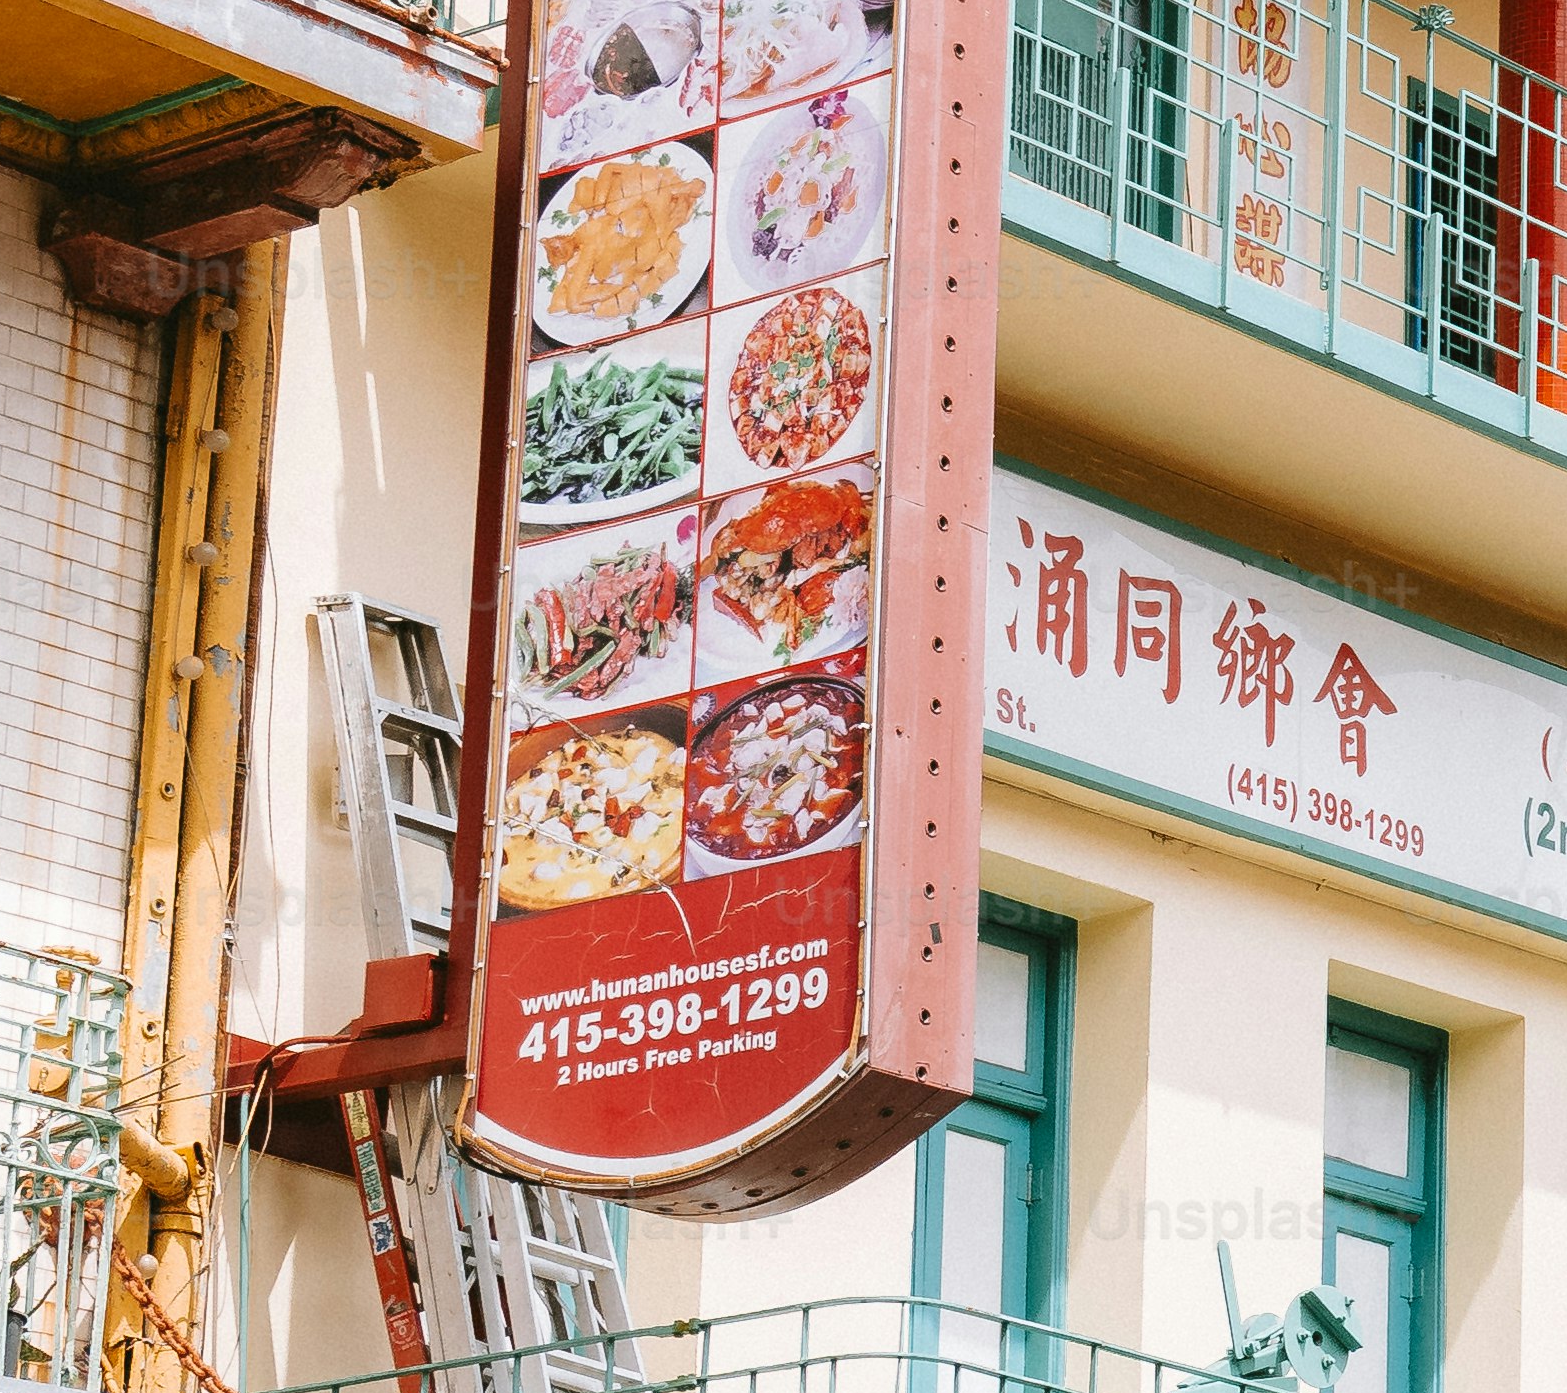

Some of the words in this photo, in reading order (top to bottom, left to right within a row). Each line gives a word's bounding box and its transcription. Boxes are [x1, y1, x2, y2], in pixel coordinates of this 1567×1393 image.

[996, 687, 1036, 733] St.
[1227, 763, 1300, 824] (415)
[1306, 787, 1426, 859] 398-1299
[518, 965, 830, 1064] 415-398-1299
[520, 934, 829, 1016] www.hunanhousesf.com
[557, 1064, 572, 1087] 2
[577, 1052, 641, 1082] Hours
[645, 1044, 692, 1072] Free
[698, 1026, 777, 1061] Parking
